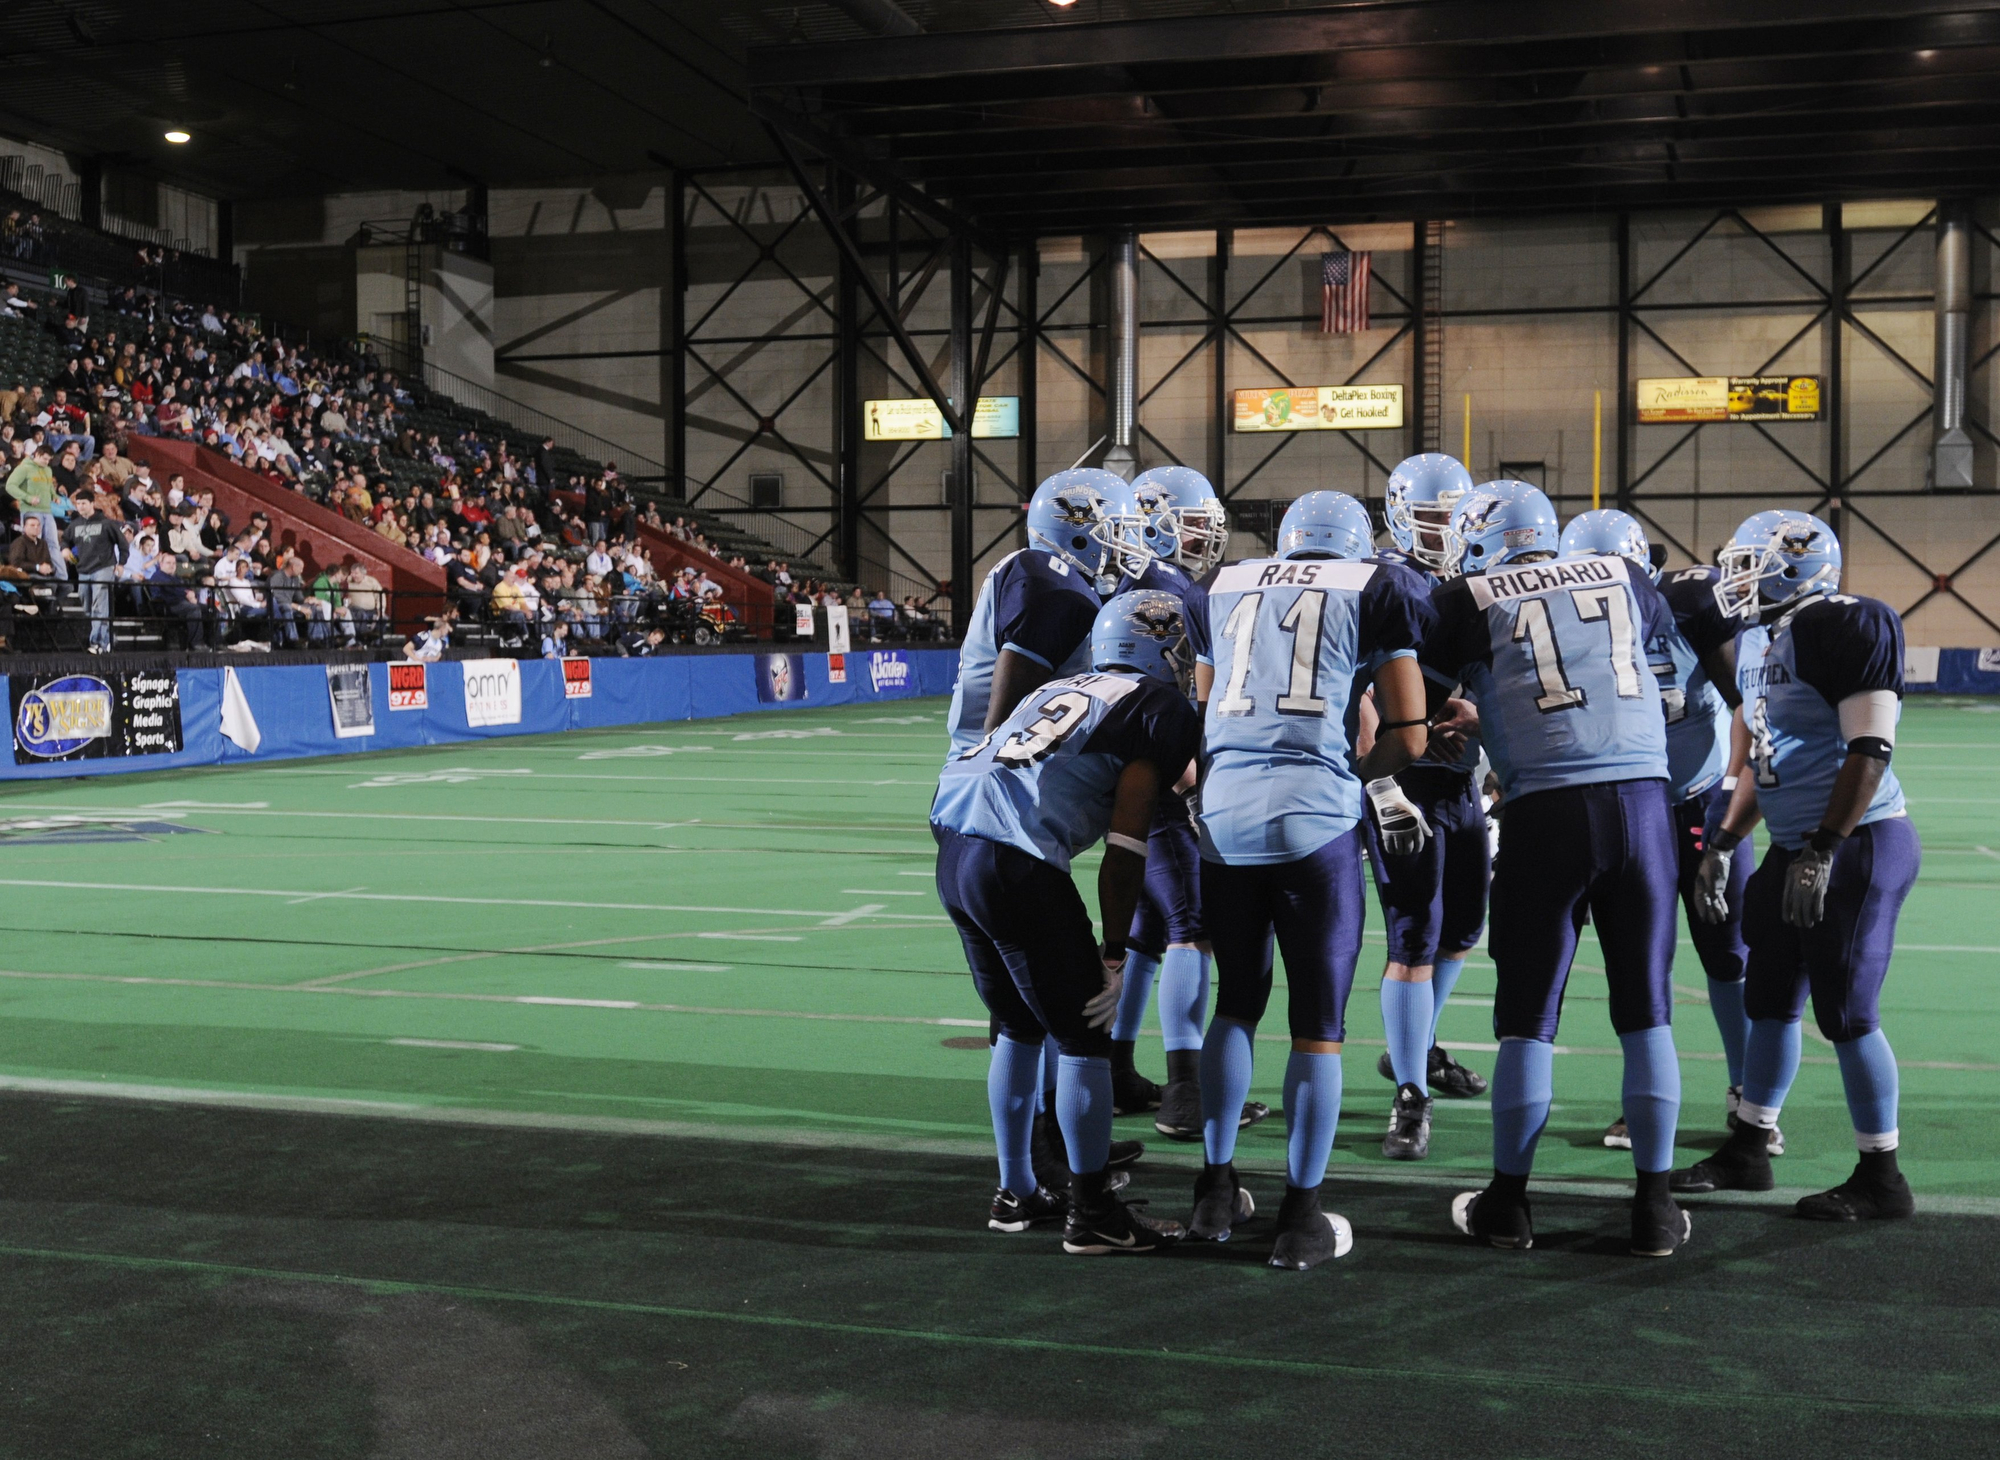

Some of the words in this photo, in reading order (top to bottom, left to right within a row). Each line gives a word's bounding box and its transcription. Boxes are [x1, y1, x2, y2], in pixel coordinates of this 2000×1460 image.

[1288, 388, 1317, 398] PIZZA
[1332, 390, 1368, 401] DeltaPlex
[1370, 388, 1397, 402] Boxing
[1655, 385, 1708, 404] Radisson
[1341, 408, 1354, 419] Get
[1356, 406, 1389, 418] Hooked!
[1740, 413, 1780, 421] Appointment
[1073, 511, 1084, 519] 36
[1258, 564, 1323, 586] RAS
[1487, 561, 1613, 599] RICHARD
[1155, 624, 1164, 632] 36
[1217, 588, 1330, 719] 11
[1512, 583, 1644, 715] 17
[390, 665, 425, 690] WGRD
[563, 660, 590, 680] WGRD
[869, 652, 908, 690] Baden
[1740, 663, 1792, 690] UNDER
[131, 676, 171, 694] Signage
[565, 681, 591, 695] 97.9
[132, 693, 174, 710] Graphics
[390, 690, 427, 706] 97.9
[50, 698, 106, 719] WILDE
[59, 713, 106, 735] SIGNS
[132, 713, 164, 728] Media
[134, 732, 166, 748] Sports
